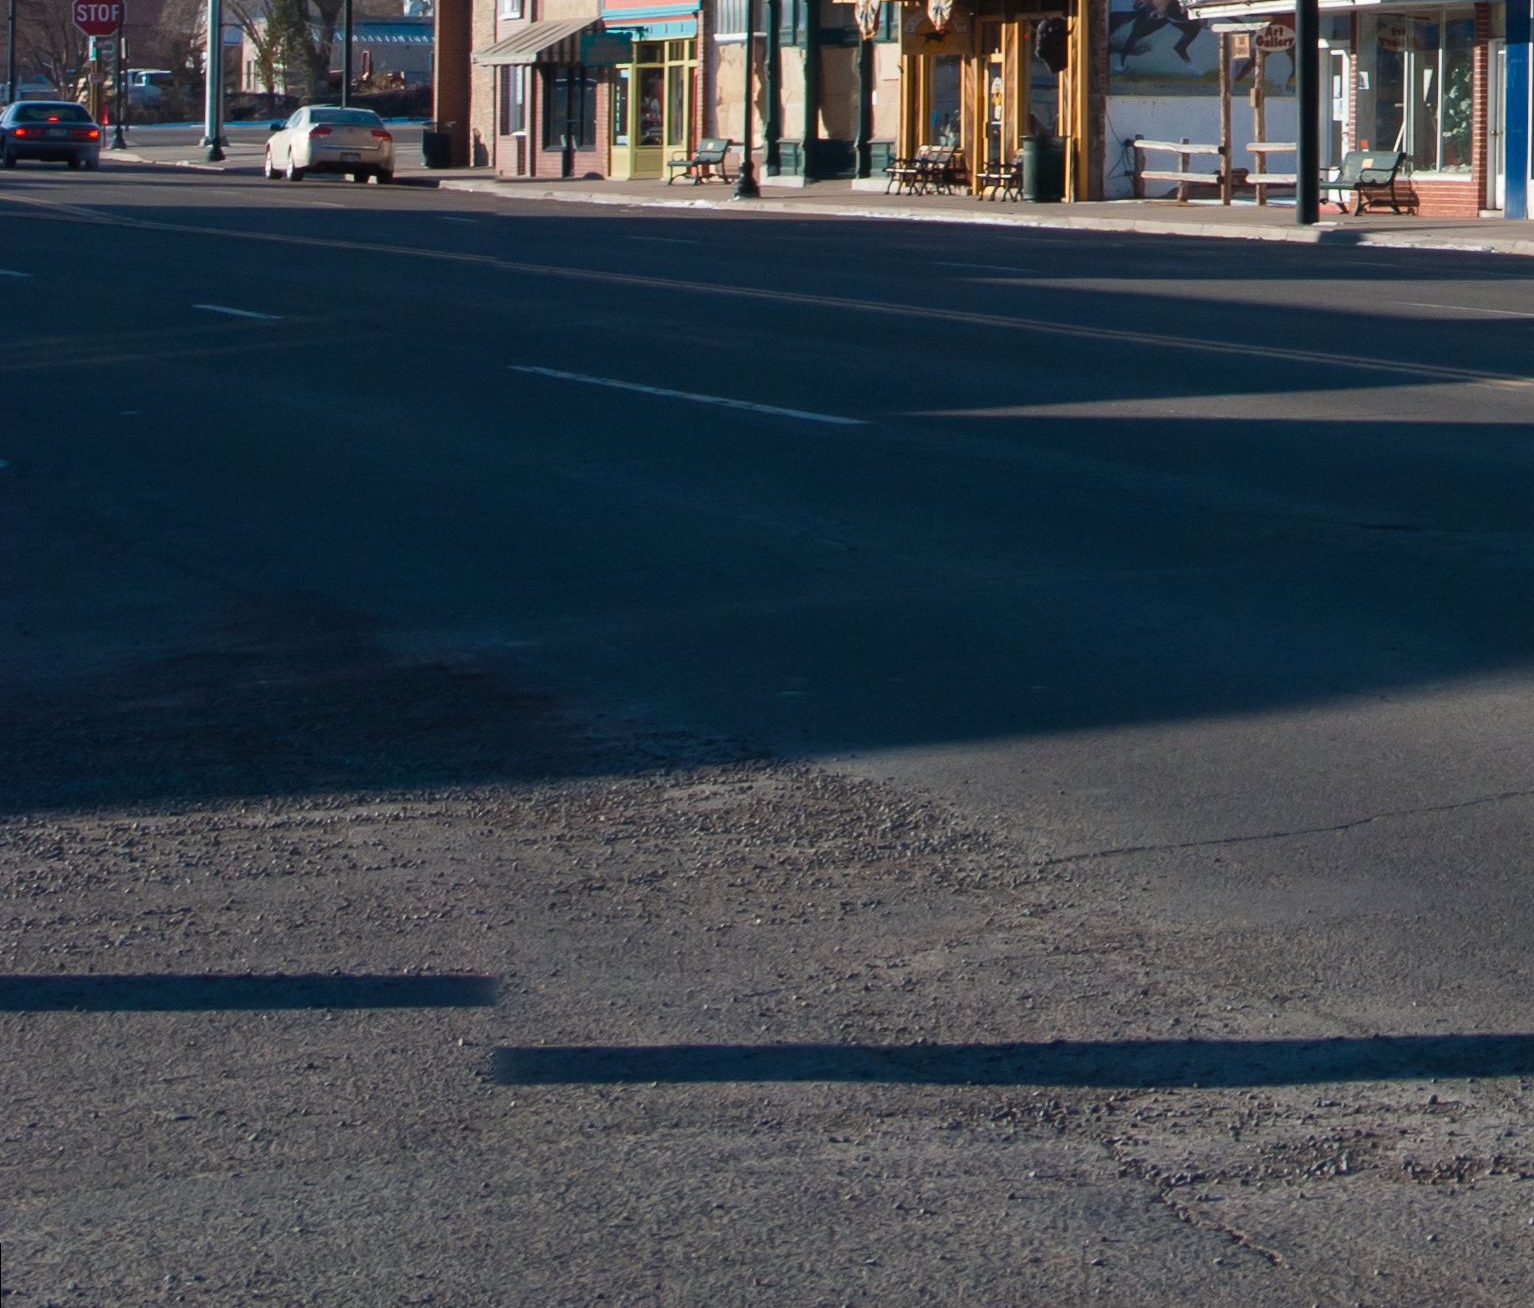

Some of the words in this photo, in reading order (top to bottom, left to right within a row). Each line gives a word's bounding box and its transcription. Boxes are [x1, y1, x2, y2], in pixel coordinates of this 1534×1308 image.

[76, 4, 120, 22] STOP
[1265, 26, 1284, 37] Art
[1256, 34, 1295, 48] Gallery
